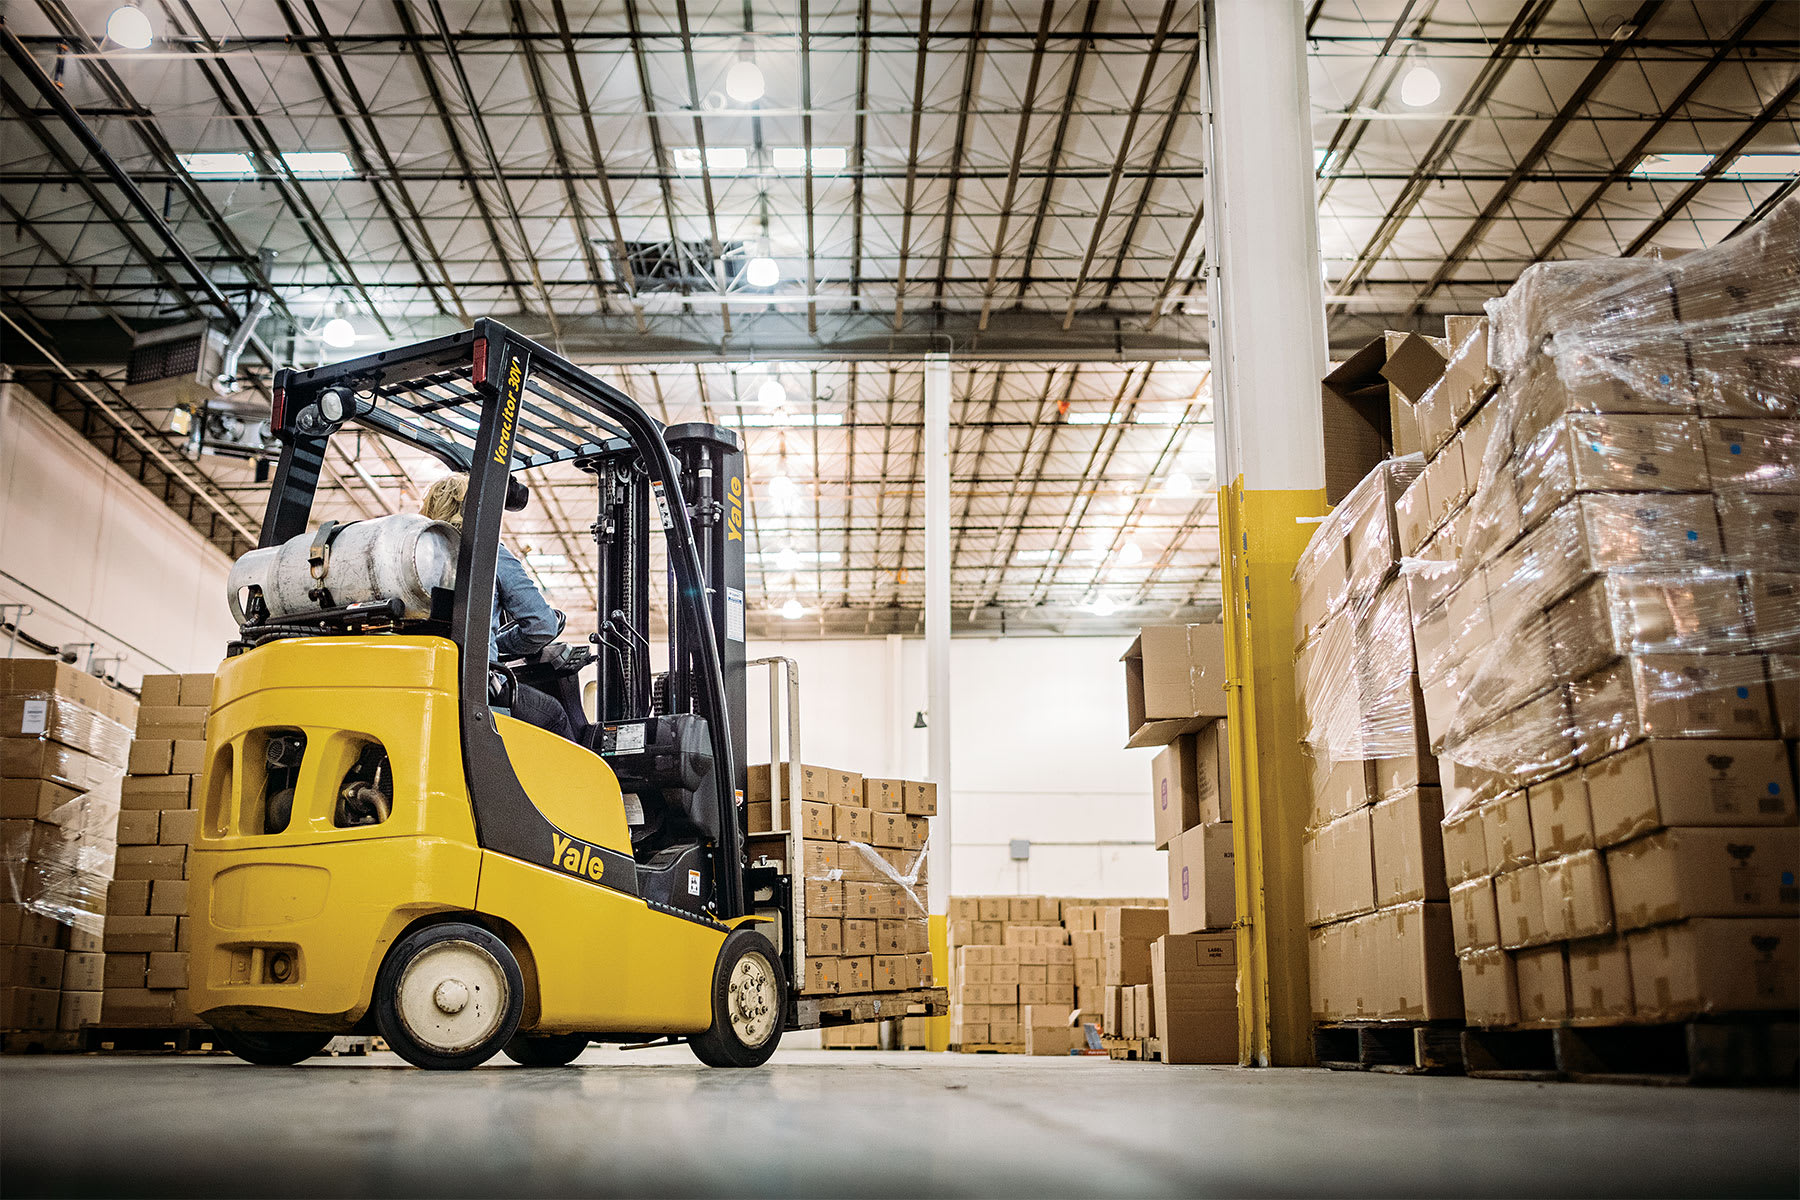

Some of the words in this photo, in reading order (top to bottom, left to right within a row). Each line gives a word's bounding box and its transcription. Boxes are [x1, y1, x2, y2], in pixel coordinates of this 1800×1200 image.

[493, 390, 516, 465] Veracitor
[727, 476, 742, 542] Yale
[552, 832, 604, 880] Yale
